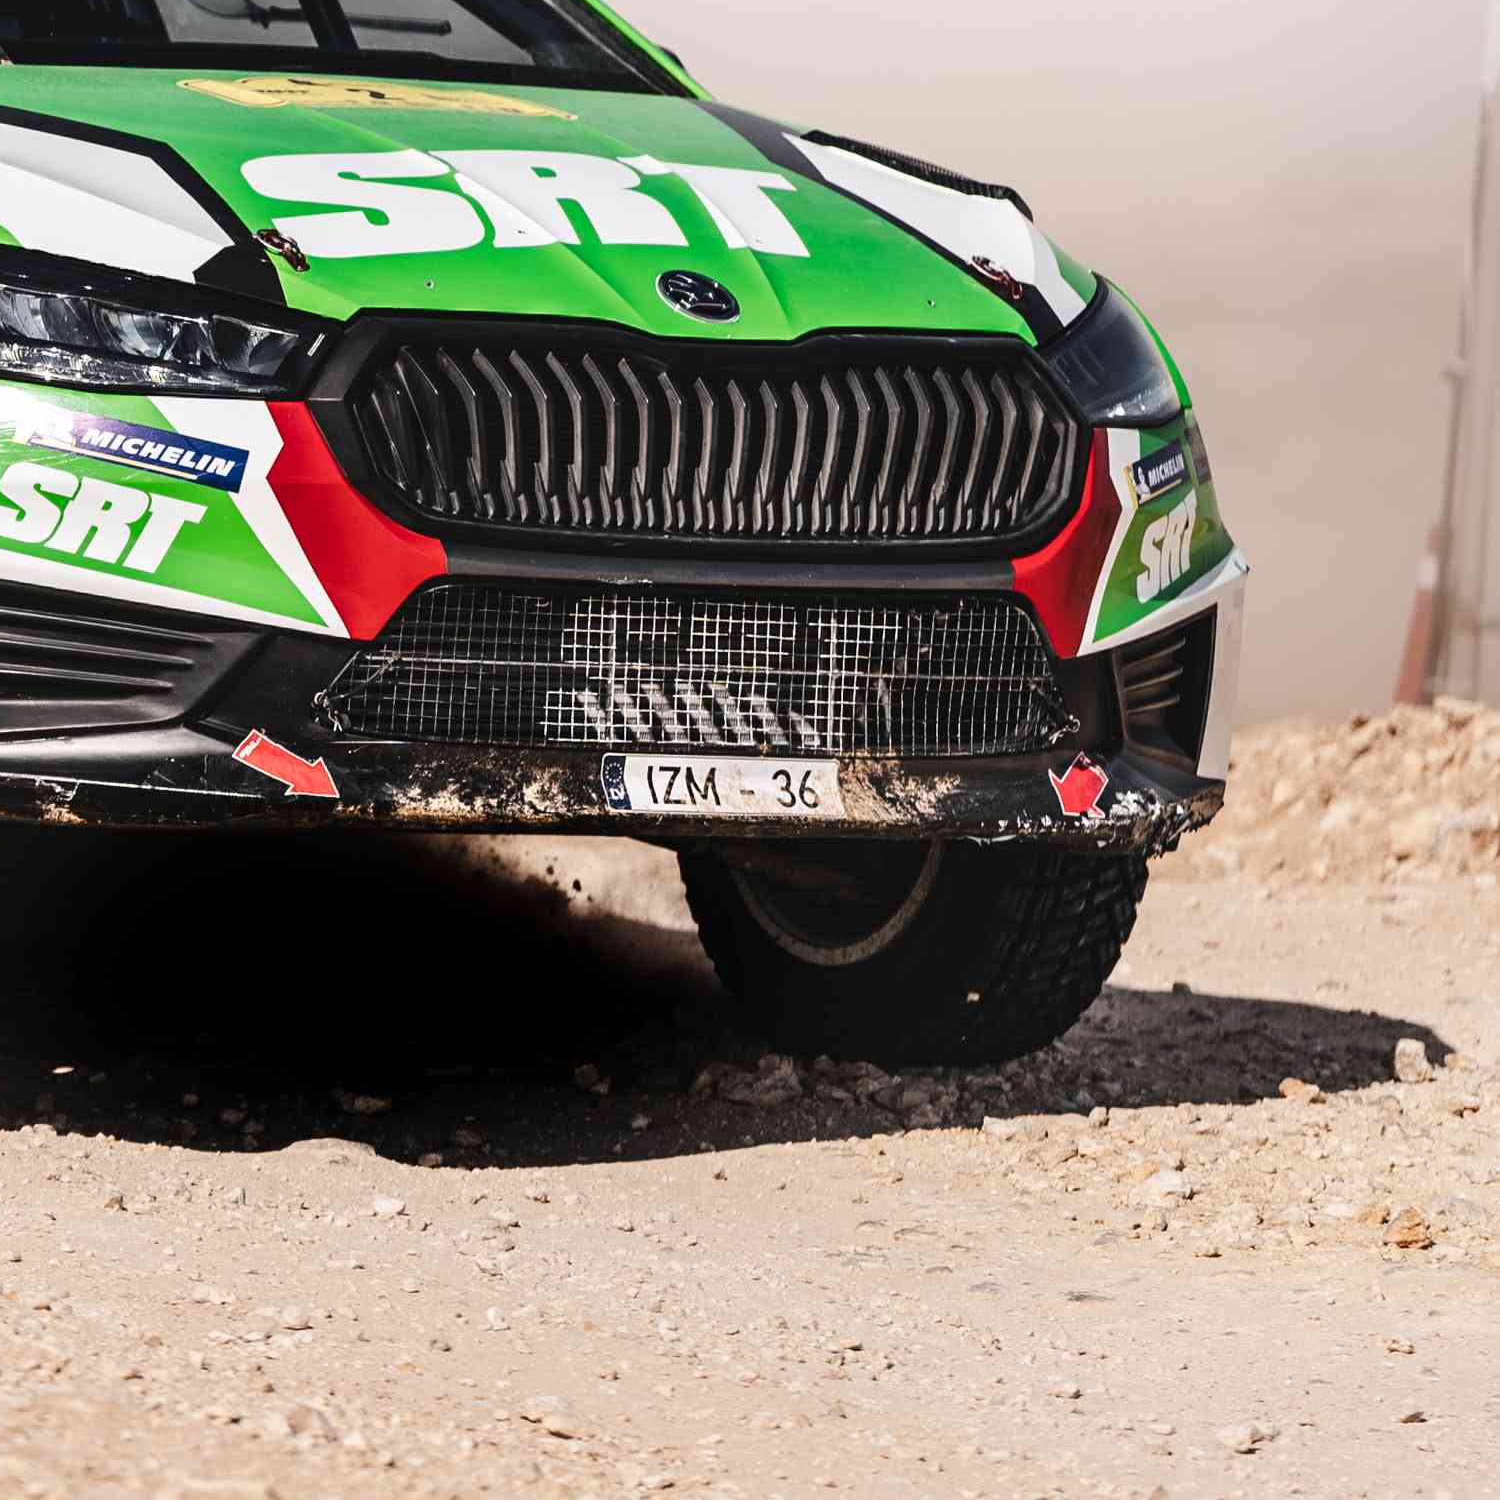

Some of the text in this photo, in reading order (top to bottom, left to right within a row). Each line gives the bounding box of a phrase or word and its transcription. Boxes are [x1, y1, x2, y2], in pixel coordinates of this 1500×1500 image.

[240, 147, 811, 259] SRT
[81, 428, 237, 478] MICHELIN
[1136, 487, 1198, 604] SRT
[646, 765, 722, 807] IZM
[771, 768, 820, 809] 36
